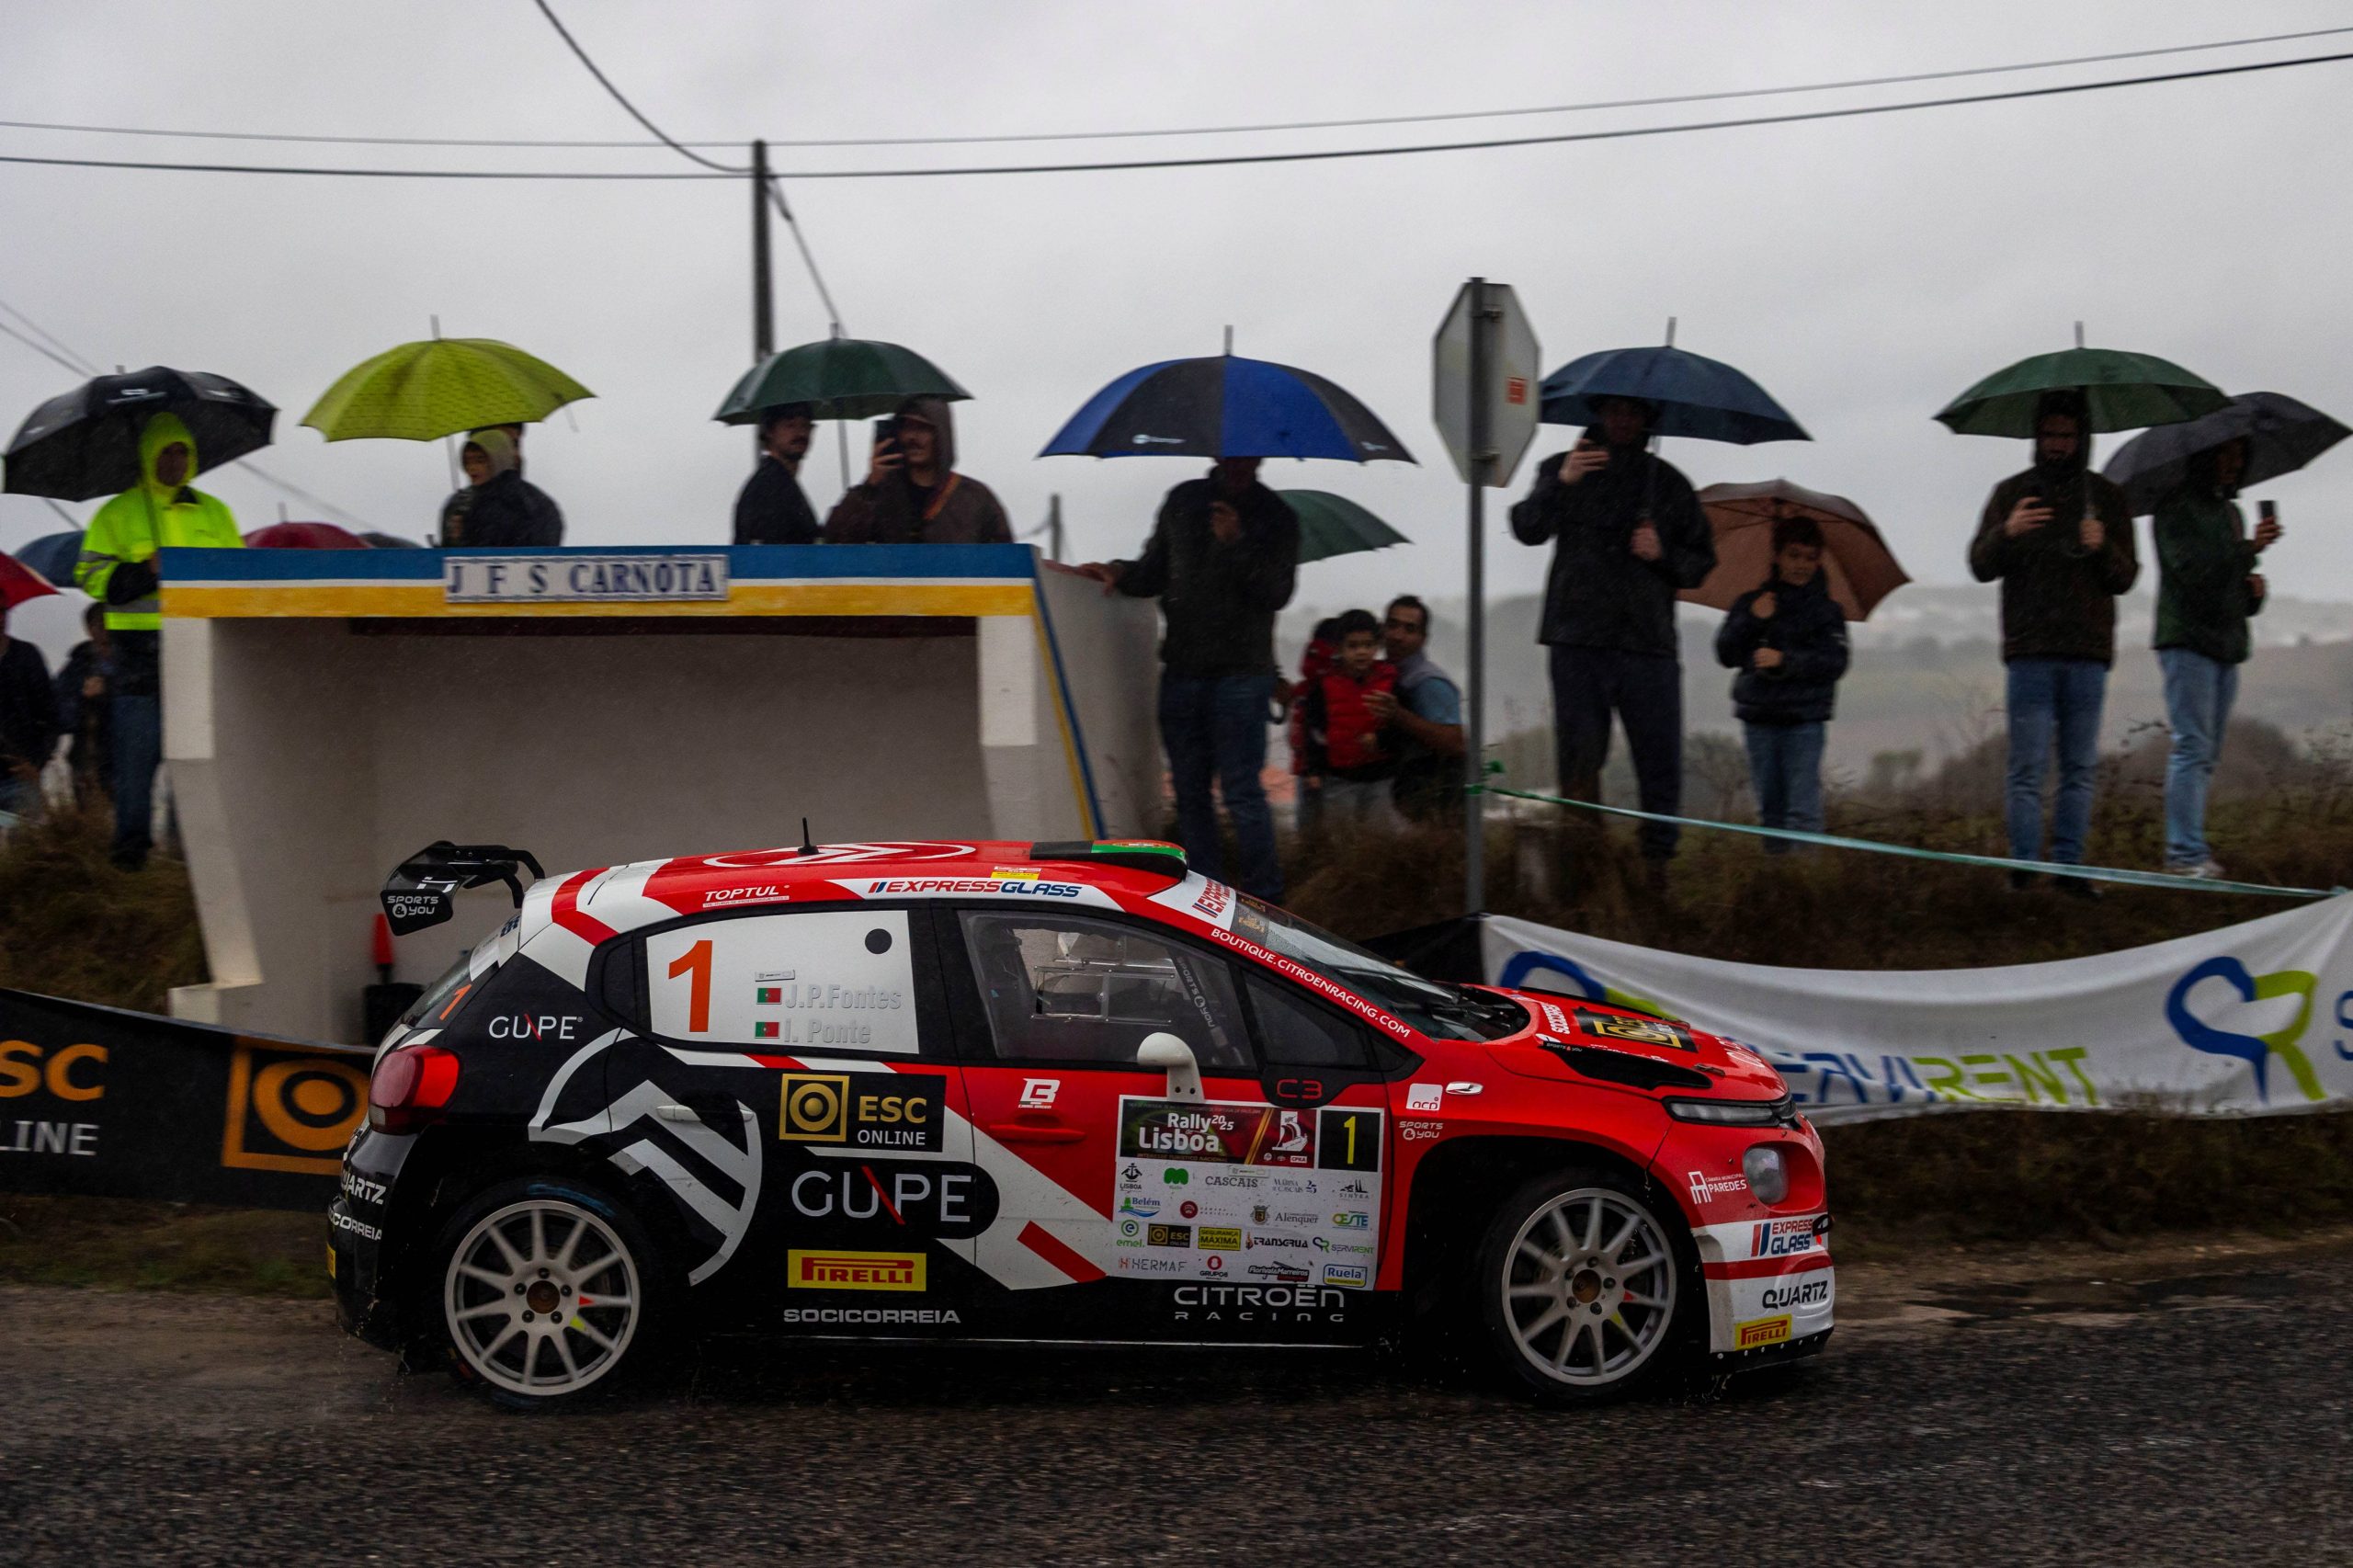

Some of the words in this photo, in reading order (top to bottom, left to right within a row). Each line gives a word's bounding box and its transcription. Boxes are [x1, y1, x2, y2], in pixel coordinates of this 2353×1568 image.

[448, 564, 463, 594] J
[487, 564, 506, 594] F
[529, 564, 549, 594] S
[569, 562, 716, 594] CARNOTA
[387, 895, 439, 904] SPORTS
[705, 886, 779, 902] TOPTUL
[886, 881, 1083, 897] EXPRESSGLASS
[668, 939, 713, 1033] 1
[1211, 927, 1411, 1039] BOUTIQUE.CITROENRACING.COM
[439, 984, 472, 1021] 1
[807, 1019, 871, 1043] Ponte
[1726, 1037, 2098, 1106] ERVIRENT
[1276, 1078, 1323, 1100] C3
[858, 1096, 927, 1123] ESC
[1167, 1112, 1211, 1133] Rally
[1399, 1121, 1443, 1130] SPORTS
[857, 1130, 926, 1146] ONLINE
[1139, 1127, 1219, 1153] Lisboa
[1344, 1116, 1357, 1165] 1
[1205, 1176, 1257, 1187] CASCAIS
[1708, 1180, 1746, 1192] PAREDES
[1132, 1197, 1160, 1206] Belém
[1275, 1213, 1318, 1225] Alenquer
[1772, 1219, 1813, 1234] EXPRESS
[1169, 1232, 1189, 1241] ESC
[1770, 1233, 1811, 1255] GLASS
[801, 1256, 915, 1284] PIRELLI
[1328, 1267, 1361, 1278] Ruela
[1763, 1280, 1828, 1310] QUARTZ
[783, 1309, 961, 1324] SOCICORREIA
[1741, 1320, 1788, 1346] PIRELLI
